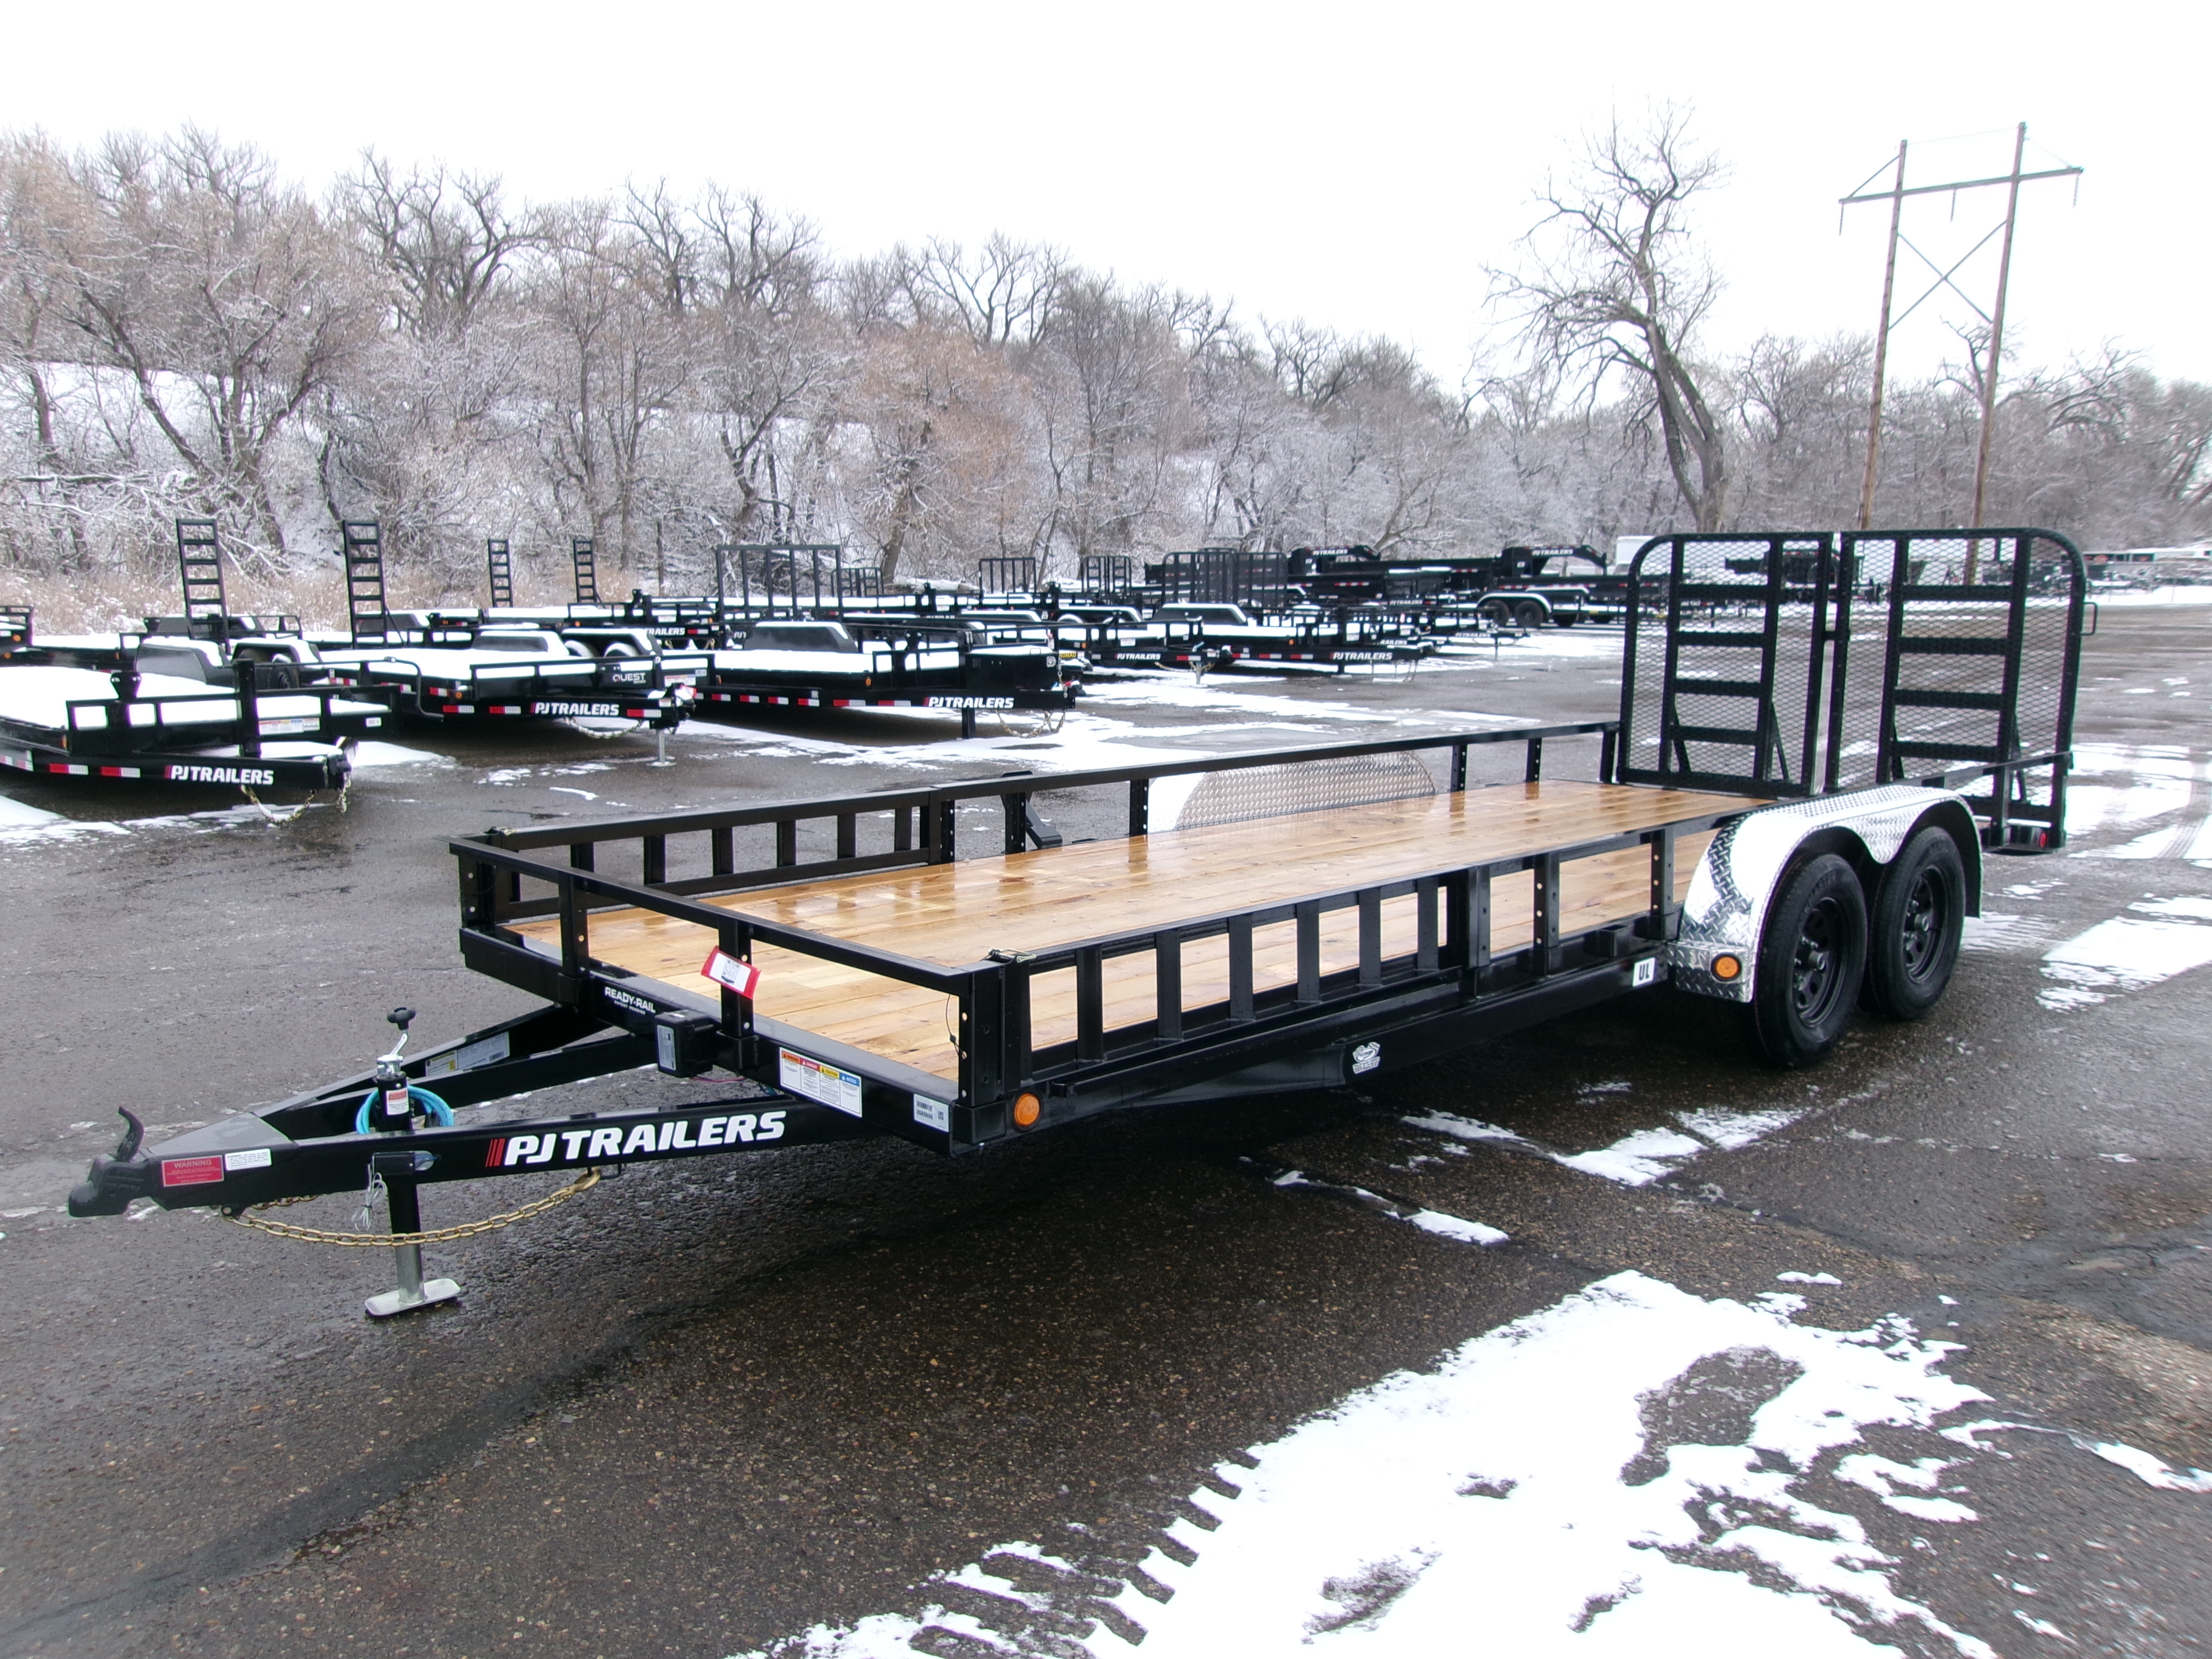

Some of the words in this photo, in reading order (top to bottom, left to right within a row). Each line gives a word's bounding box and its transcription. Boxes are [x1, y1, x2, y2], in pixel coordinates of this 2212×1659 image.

[1344, 652, 1393, 661] TRAILERS
[613, 673, 646, 682] QUEST
[945, 697, 1015, 709] TRAILERS
[551, 703, 620, 716] TRAILERS
[190, 766, 275, 785] TRAILERS
[1639, 962, 1650, 981] UL
[561, 1111, 787, 1160] TRAILERS
[174, 1159, 212, 1168] WARNING
